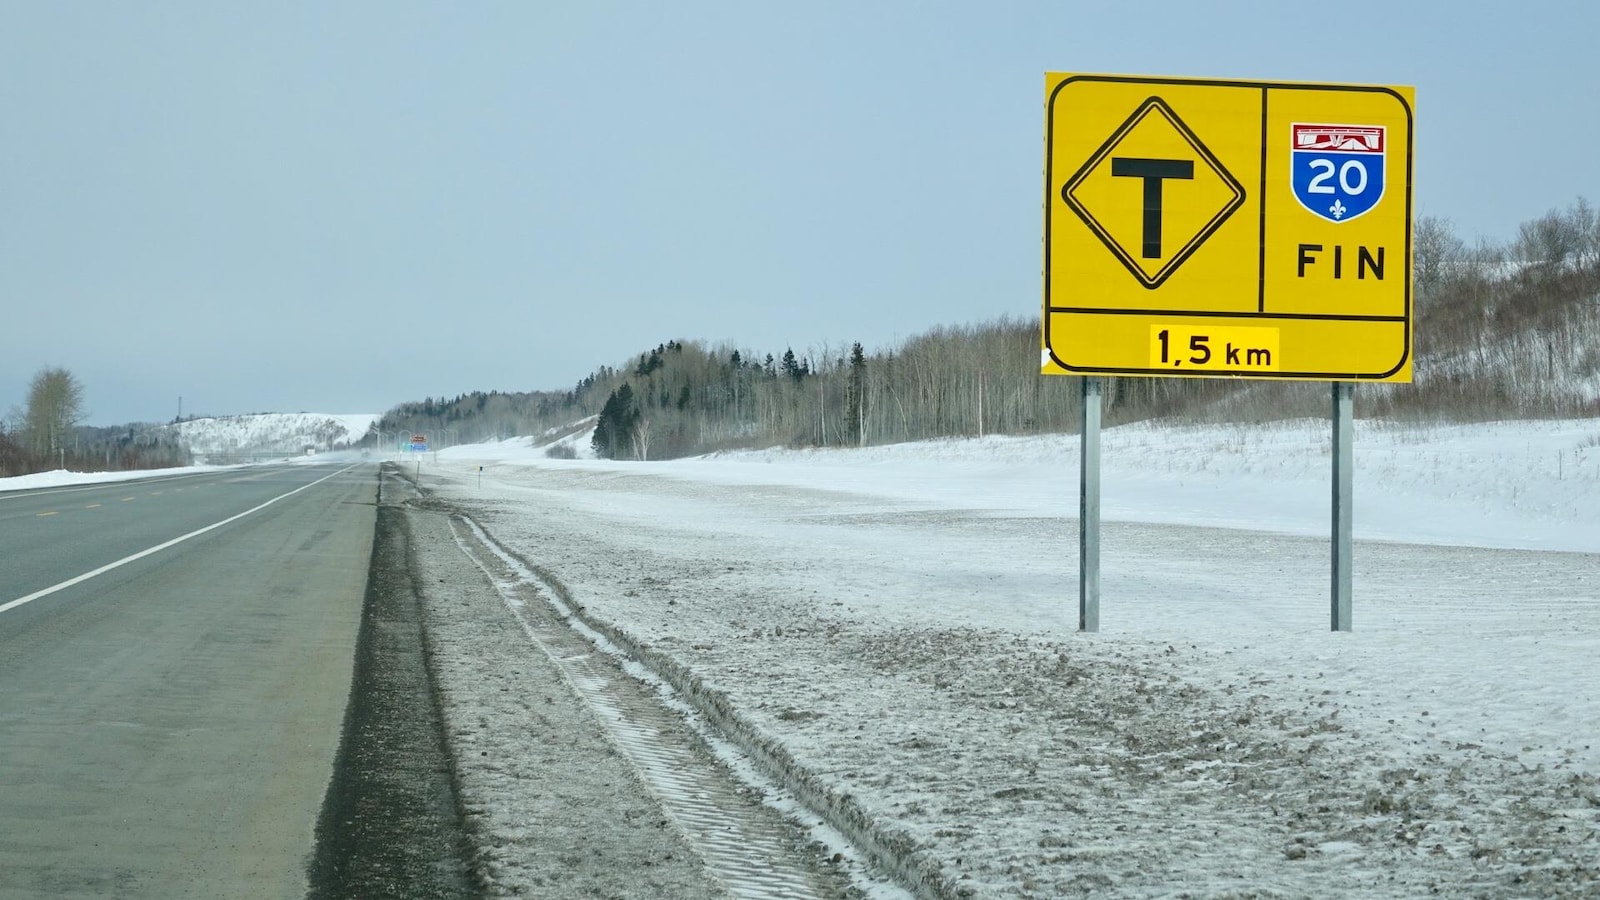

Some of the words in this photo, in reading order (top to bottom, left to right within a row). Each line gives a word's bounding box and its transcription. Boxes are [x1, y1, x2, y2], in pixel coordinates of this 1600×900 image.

[1307, 158, 1368, 196] 20
[1297, 243, 1385, 280] FIN
[1158, 329, 1211, 367] 1,5
[1225, 342, 1271, 366] km
